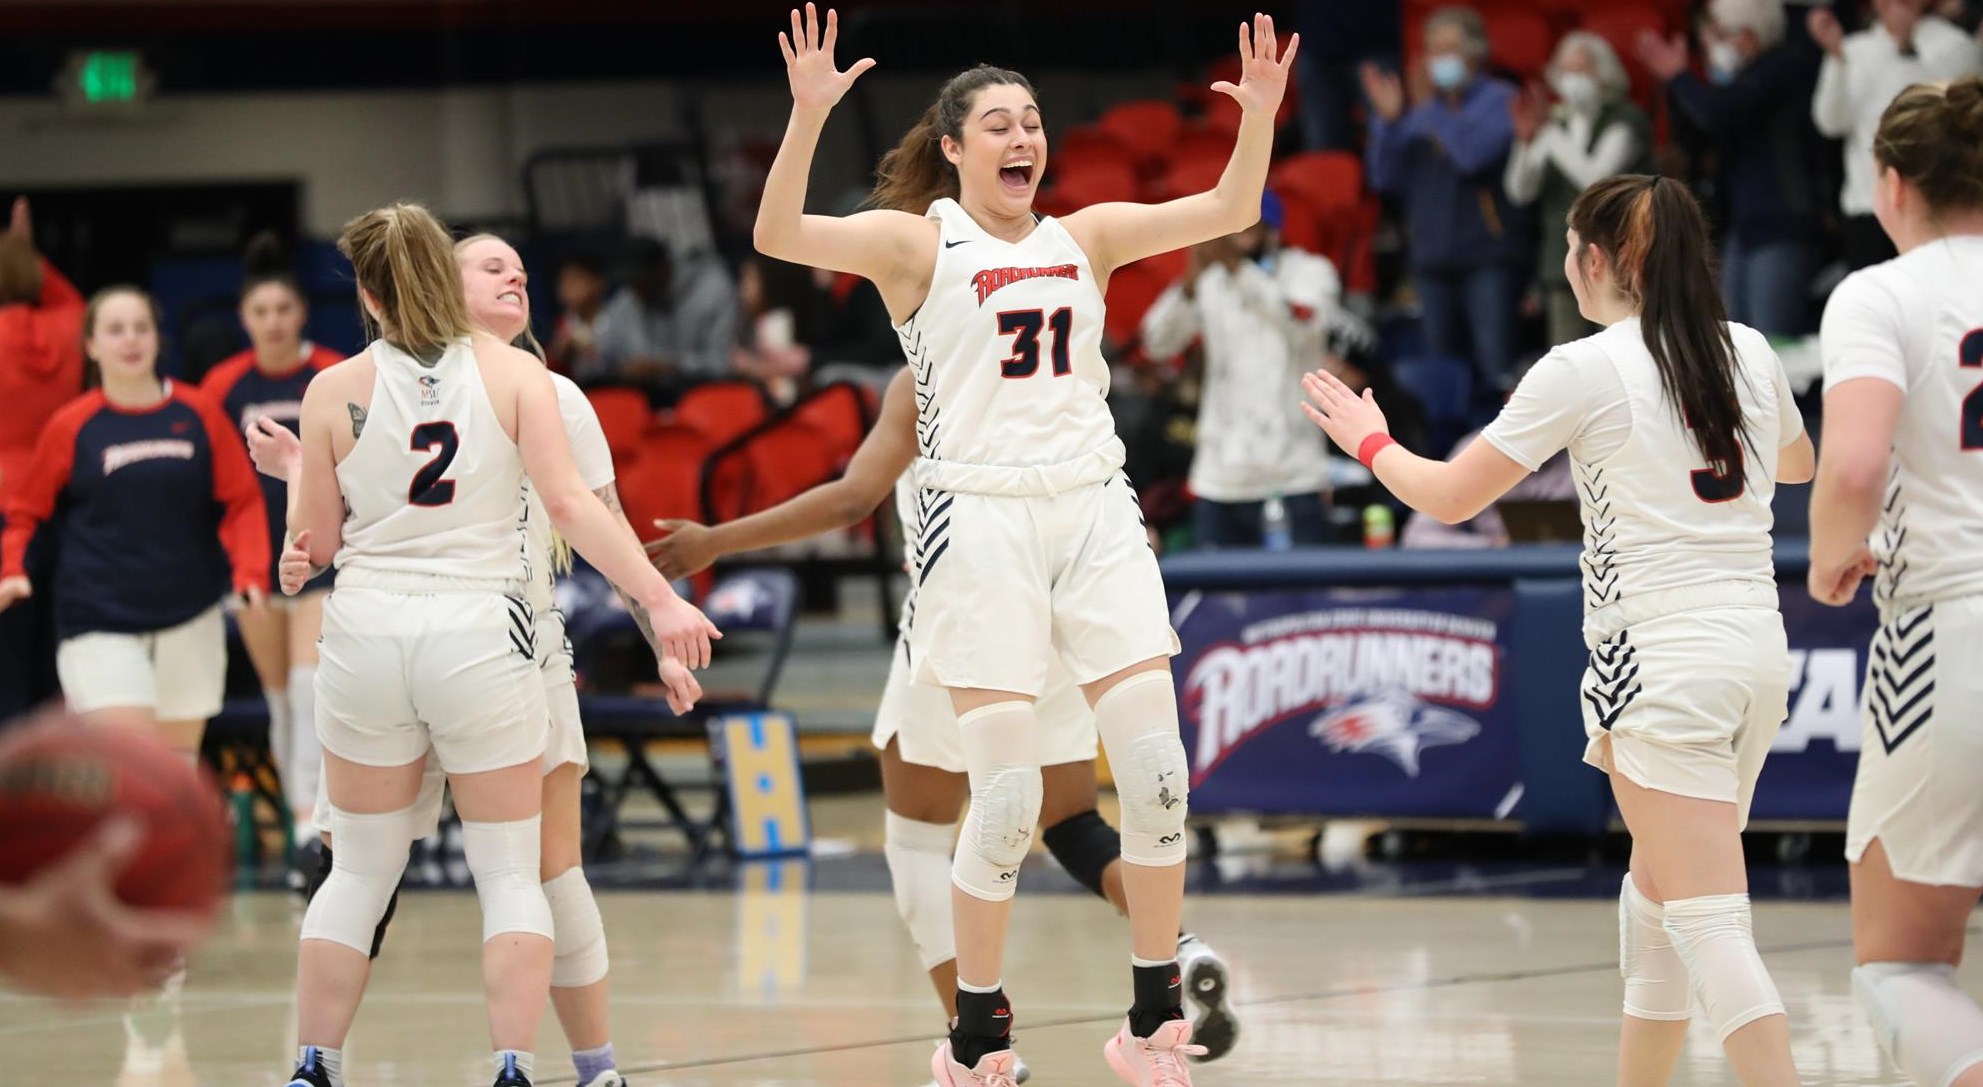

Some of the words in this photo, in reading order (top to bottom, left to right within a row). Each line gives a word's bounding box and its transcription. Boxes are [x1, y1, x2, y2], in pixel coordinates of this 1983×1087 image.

[970, 264, 1079, 309] ROADRUNNERS
[996, 306, 1073, 379] 31
[408, 420, 459, 507] 2
[1185, 635, 1498, 782] ROADRUNNERS
